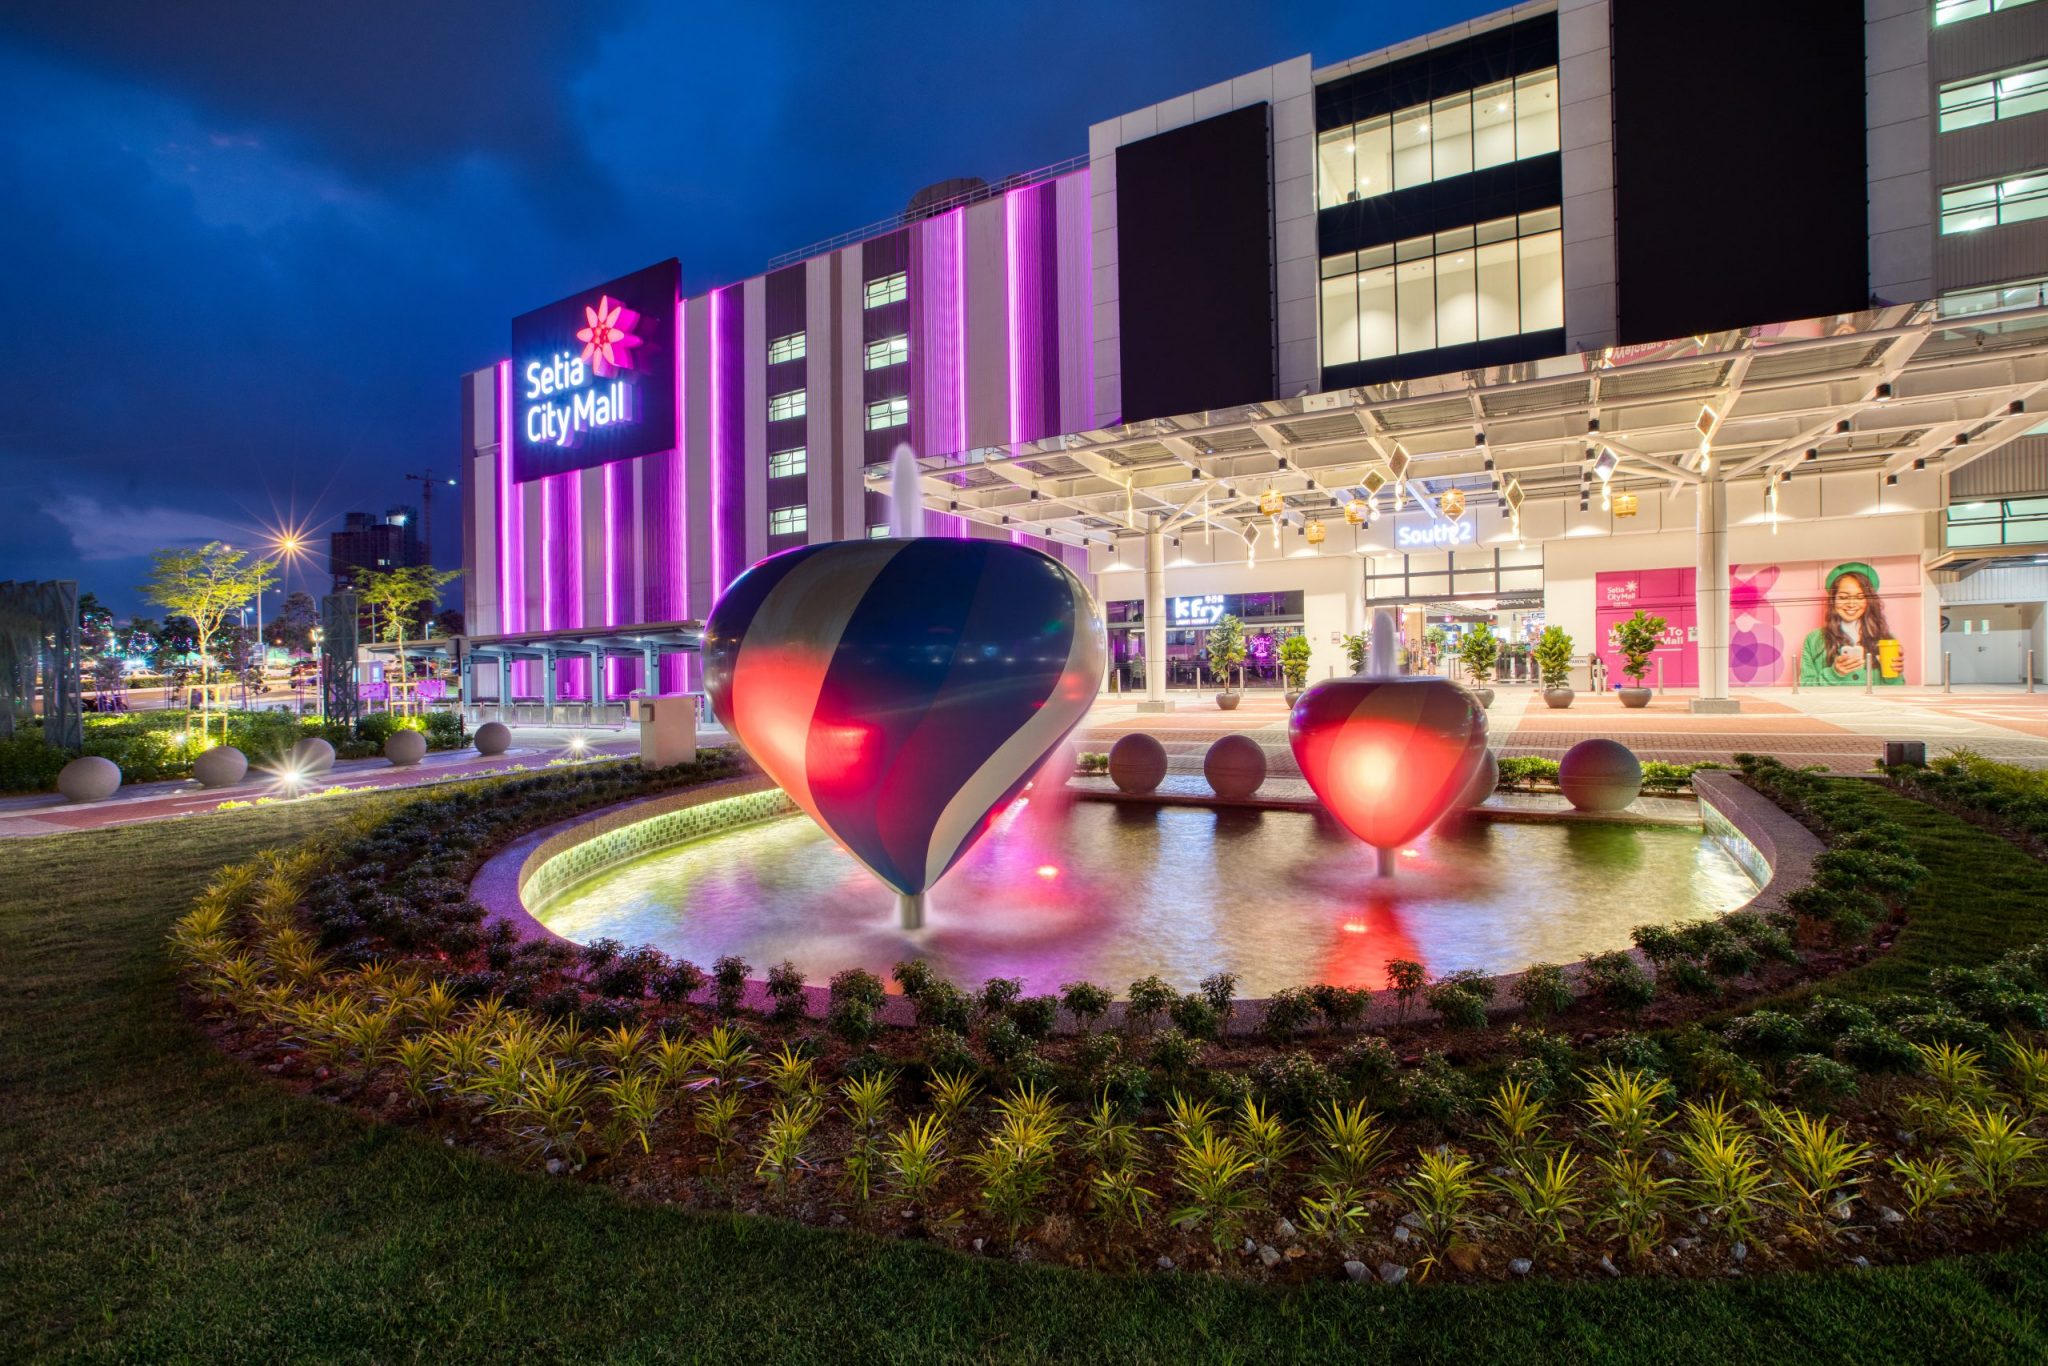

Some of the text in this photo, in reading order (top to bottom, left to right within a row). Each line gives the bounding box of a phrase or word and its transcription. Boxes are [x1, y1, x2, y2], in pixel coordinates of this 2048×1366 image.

[527, 352, 584, 399] Setia
[527, 381, 624, 446] City Mall
[1398, 522, 1471, 545] South 2
[1607, 586, 1625, 594] Setia
[1621, 592, 1636, 600] Mall
[1667, 626, 1684, 636] To
[1661, 637, 1684, 645] Mall
